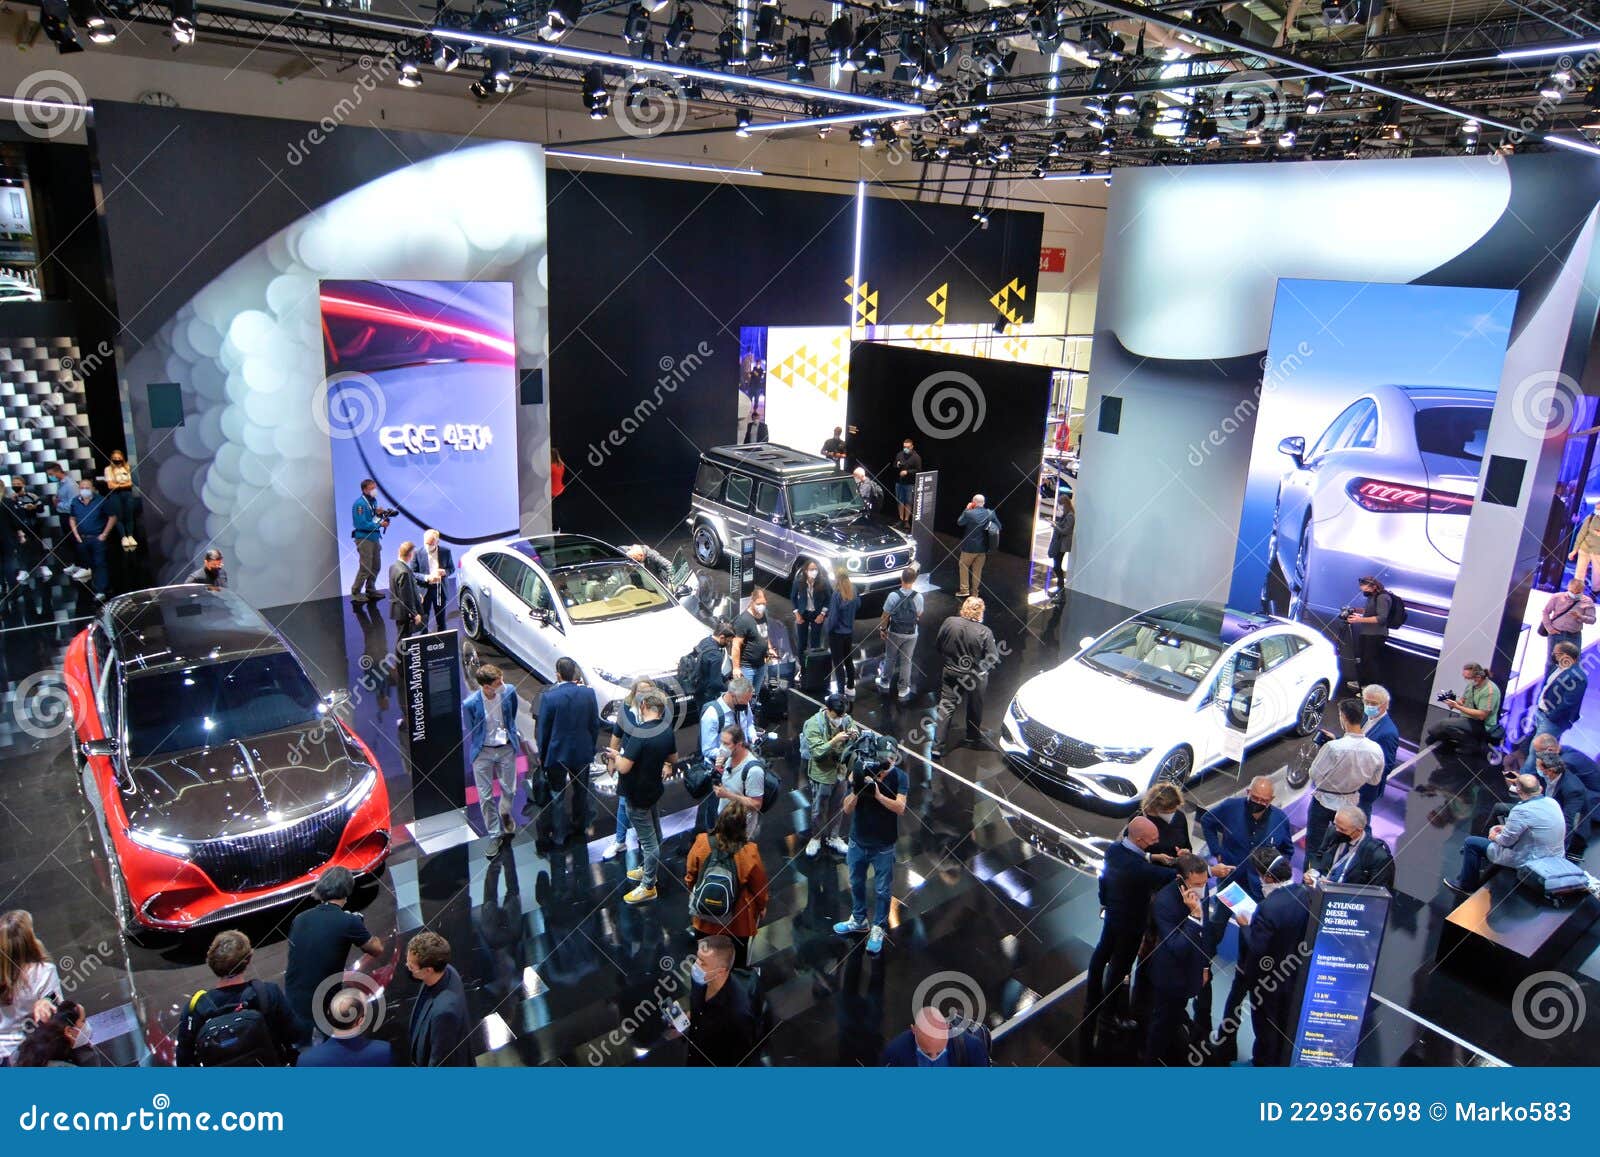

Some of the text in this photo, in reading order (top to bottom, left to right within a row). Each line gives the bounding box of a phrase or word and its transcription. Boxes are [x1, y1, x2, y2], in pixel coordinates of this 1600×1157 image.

[407, 643, 426, 742] Mercedes-Maybach
[1327, 901, 1366, 911] 4-ZYLINDER
[1325, 909, 1349, 918] DIESEL
